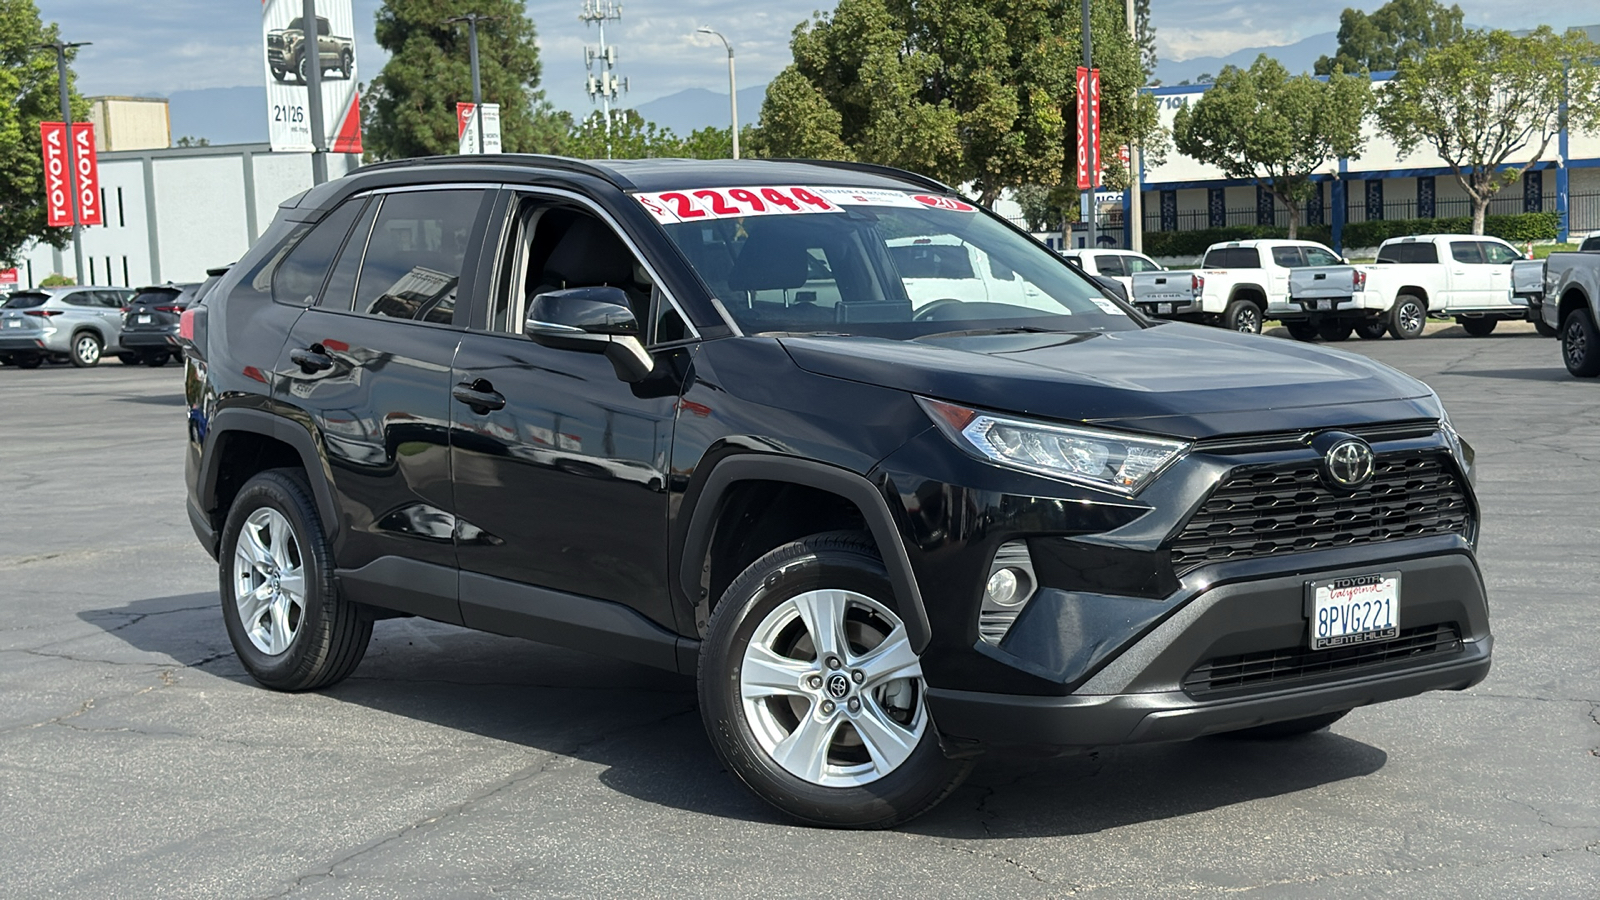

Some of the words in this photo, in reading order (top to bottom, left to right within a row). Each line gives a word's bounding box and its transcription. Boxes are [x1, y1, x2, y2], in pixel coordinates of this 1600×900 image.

[274, 104, 304, 123] 21/26
[1078, 76, 1087, 182] TOYOTA
[47, 129, 66, 221] TOYOTA
[76, 129, 95, 220] TOYOTA
[1335, 575, 1380, 588] TOYOTA
[1318, 598, 1393, 638] 8PVG221
[1317, 633, 1363, 648] PUENTE
[1363, 629, 1395, 641] HILLS
